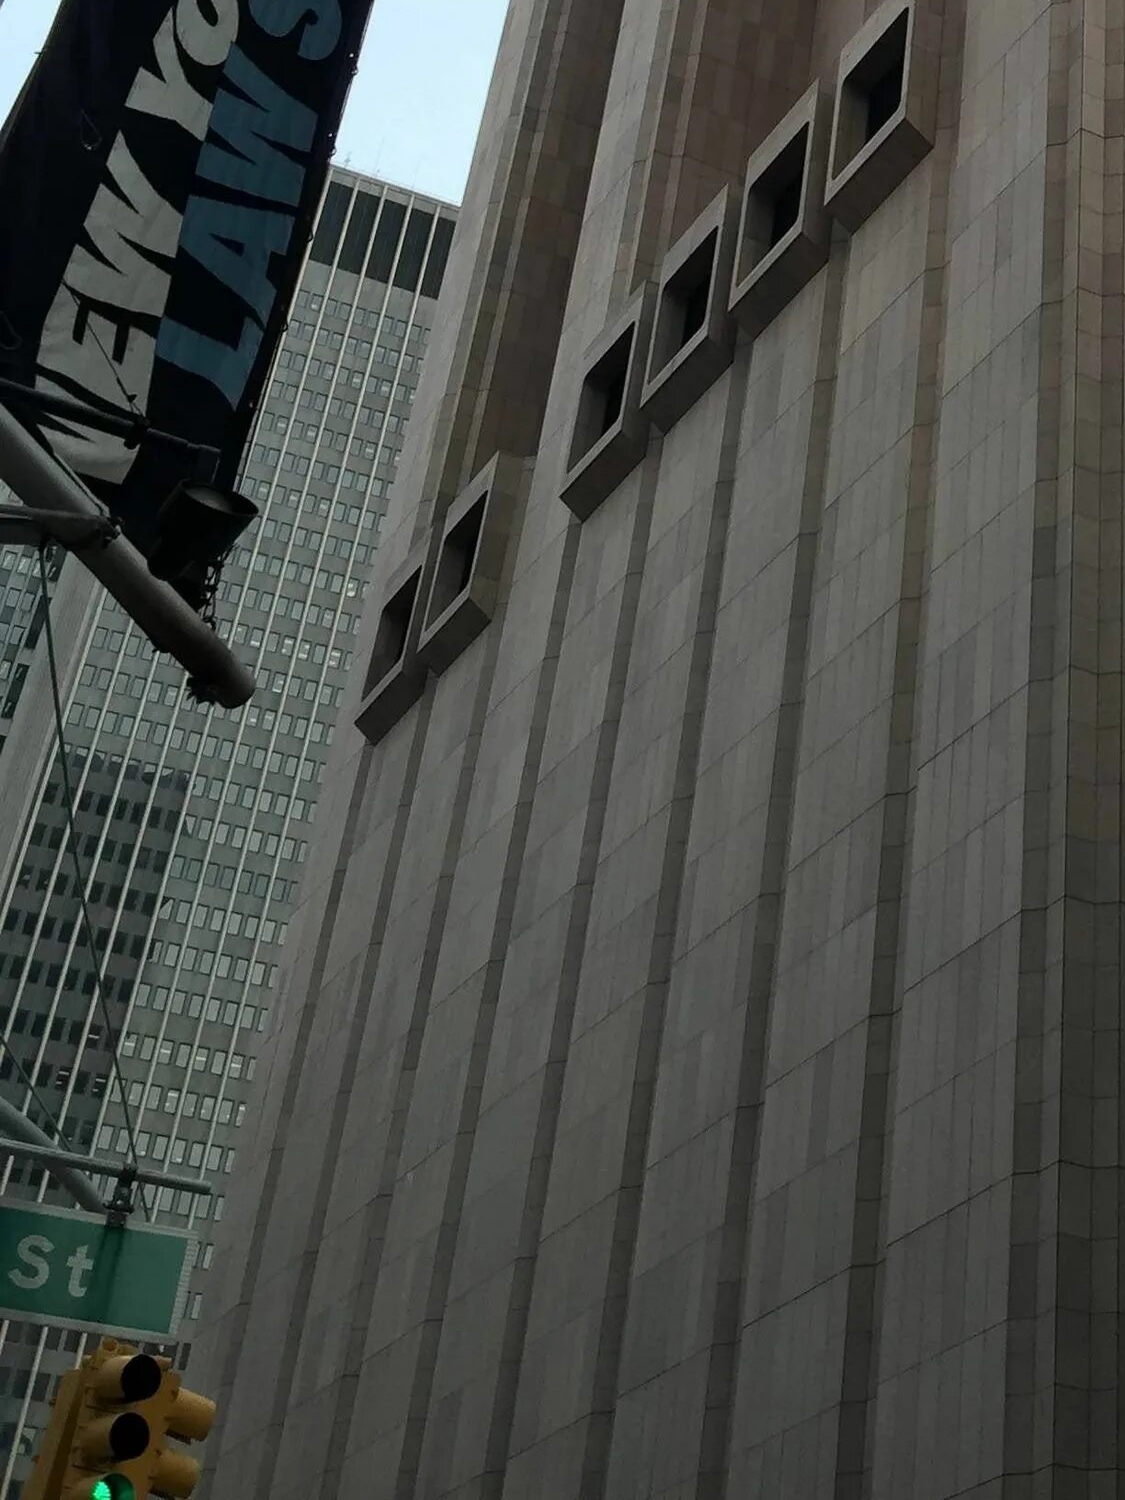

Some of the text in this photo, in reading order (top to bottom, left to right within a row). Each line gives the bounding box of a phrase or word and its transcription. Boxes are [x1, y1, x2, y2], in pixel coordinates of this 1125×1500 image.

[35, 129, 184, 485] NEW
[155, 41, 318, 412] LAW
[8, 1234, 94, 1298] St
